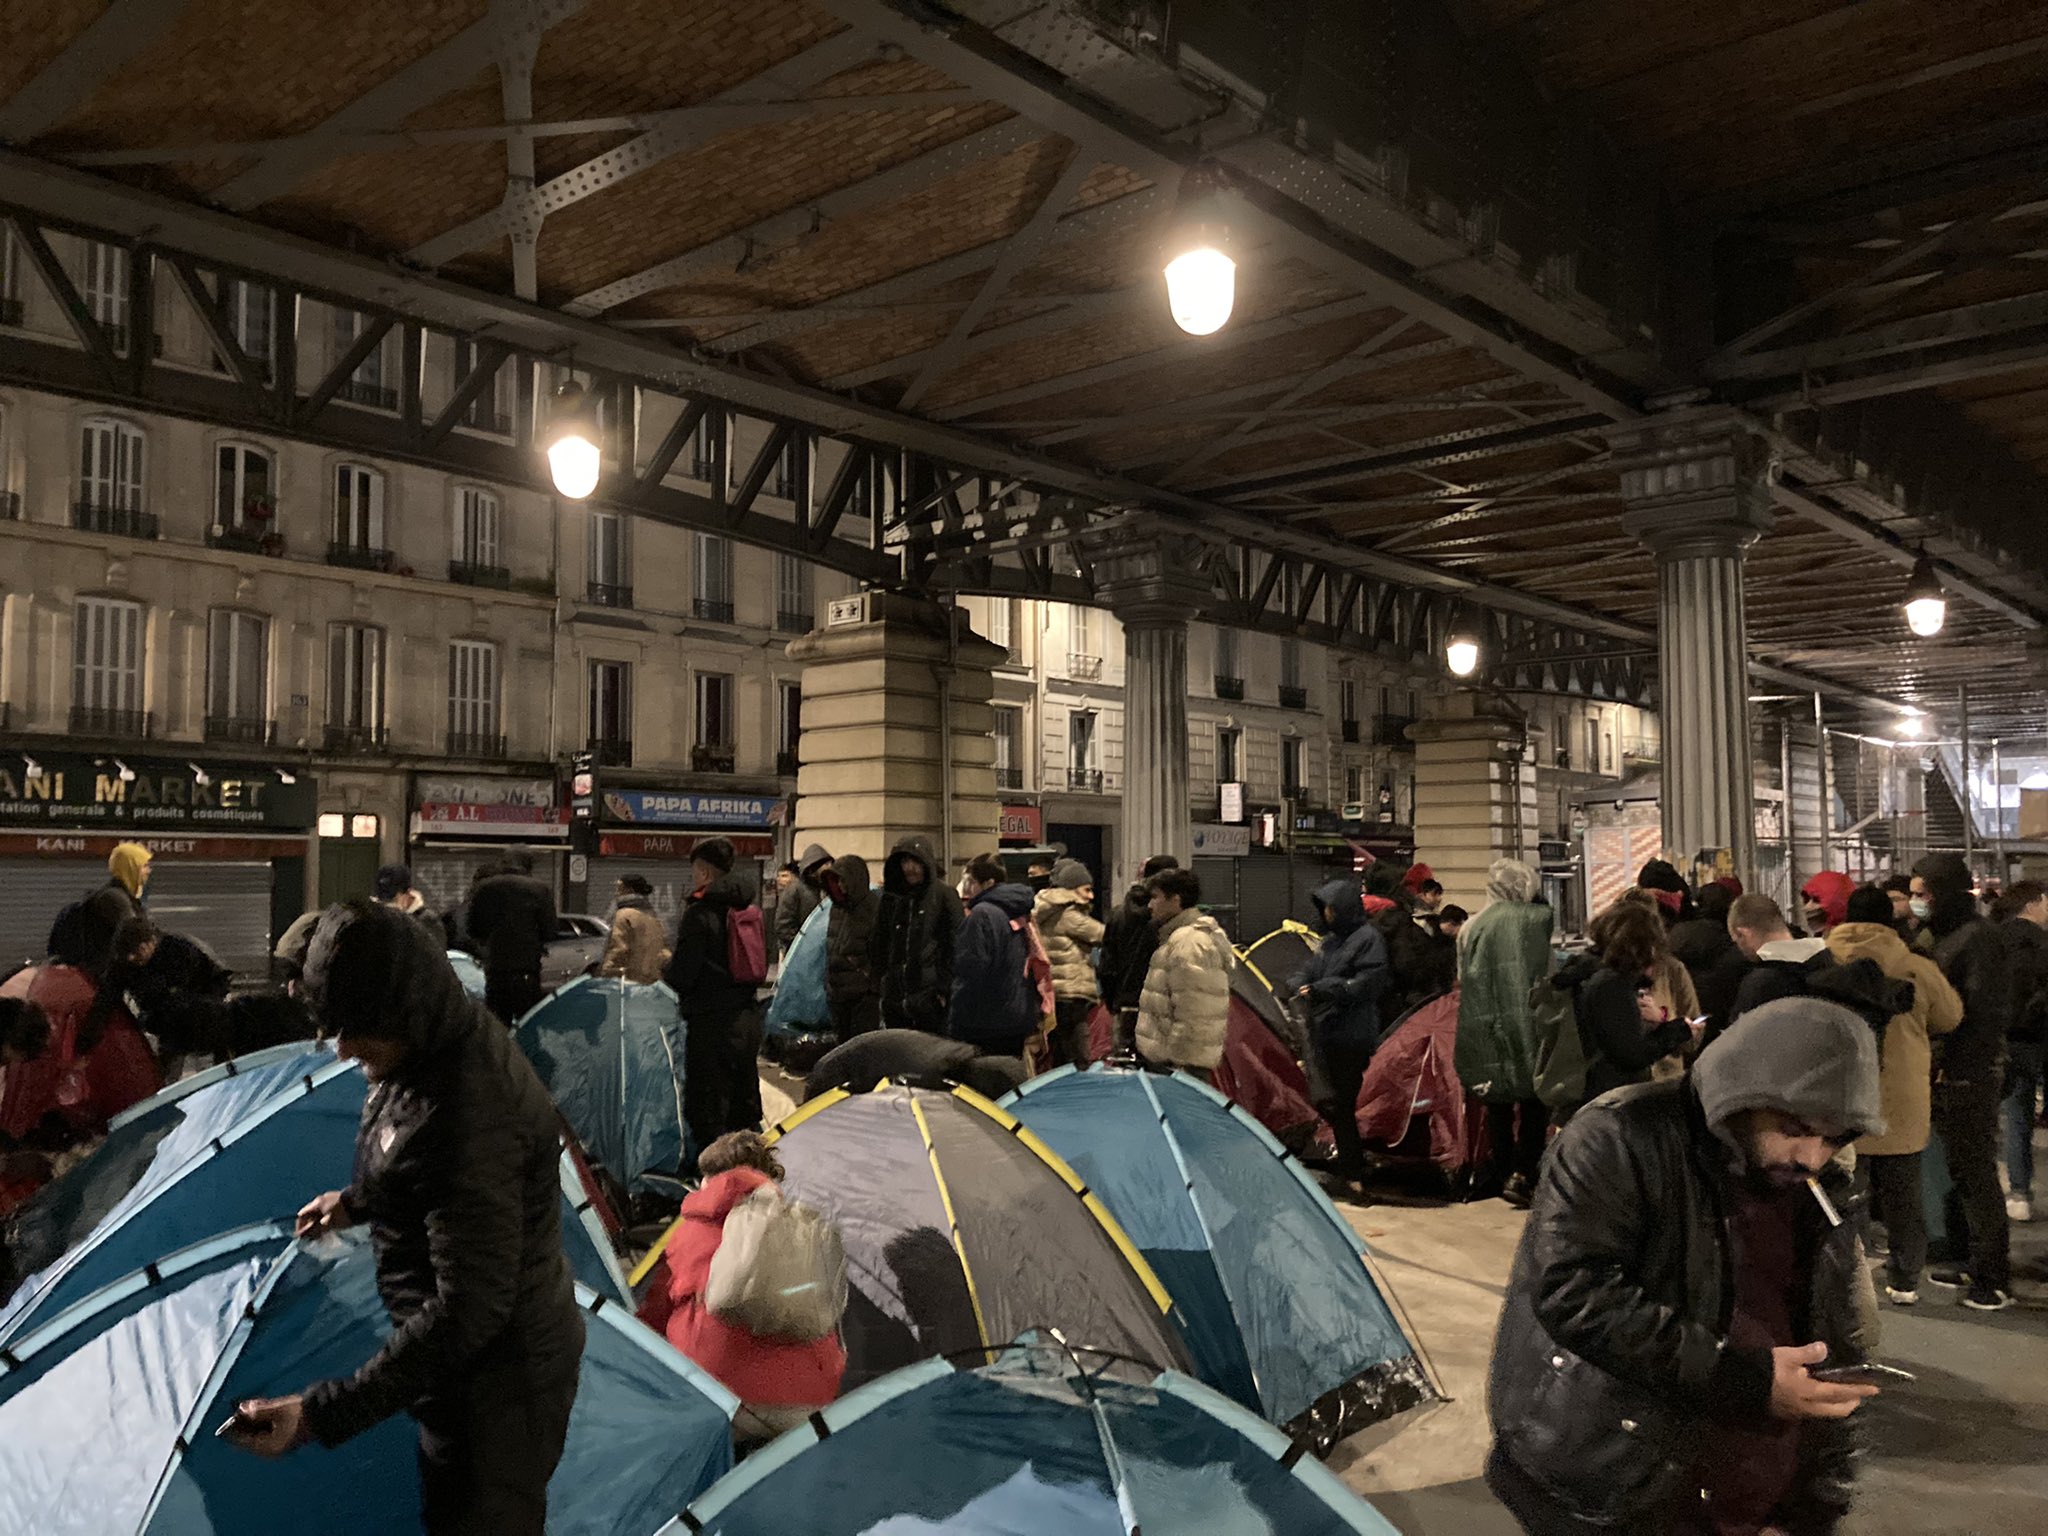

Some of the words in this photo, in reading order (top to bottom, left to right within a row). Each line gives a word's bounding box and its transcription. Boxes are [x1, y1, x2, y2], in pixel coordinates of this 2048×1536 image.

[95, 772, 266, 807] MARKET
[114, 805, 124, 816] &
[133, 807, 185, 819] produits
[642, 797, 692, 812] PAPA
[697, 799, 763, 815] AFRIKA
[36, 838, 85, 851] KANI
[644, 838, 673, 852] PAPA
